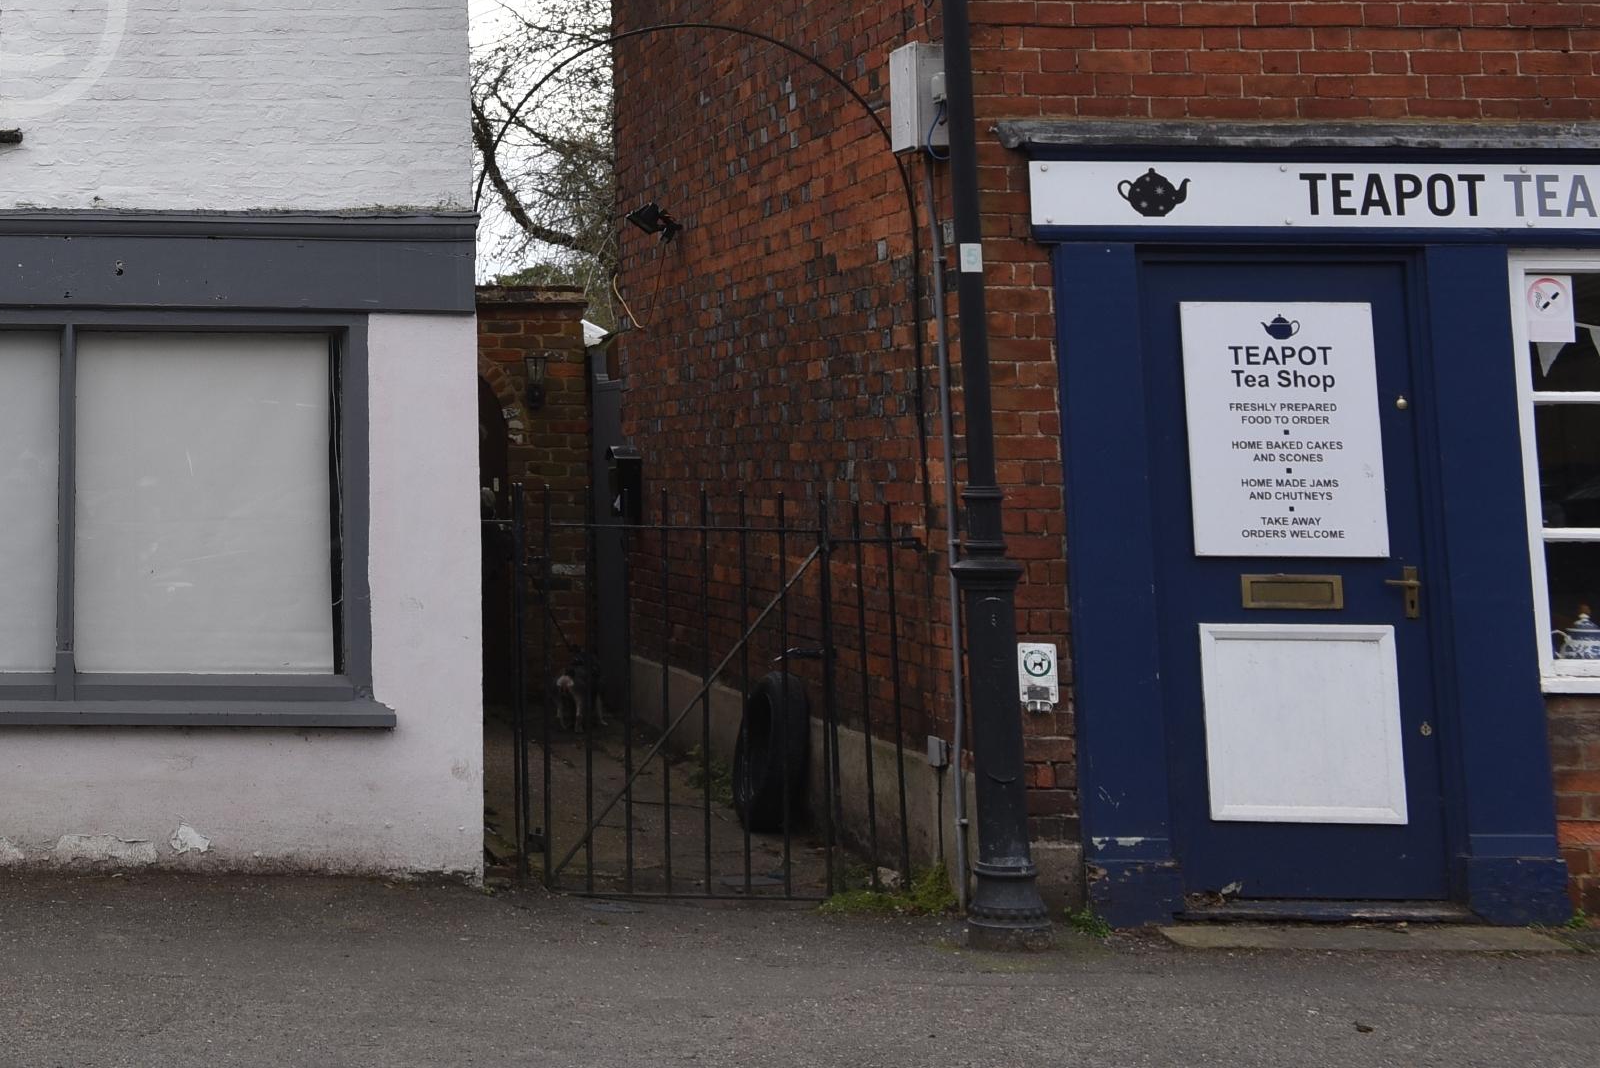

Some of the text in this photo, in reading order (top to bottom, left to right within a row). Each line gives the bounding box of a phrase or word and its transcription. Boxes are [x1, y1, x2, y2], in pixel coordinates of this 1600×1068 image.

[1299, 173, 1598, 218] TEAPOT TEA
[1228, 346, 1332, 365] TEAPOT
[1231, 370, 1335, 392] Tea Shop
[1228, 402, 1338, 412] FRESHLY PREPARED
[1241, 415, 1330, 425] FOOD TO ORDER
[1231, 440, 1344, 451] HOME BAKED CAKES
[1252, 452, 1324, 463] AND SCONES
[1241, 478, 1340, 488] HOME MADE JAMS
[1249, 491, 1333, 501] AND CHUTNEYS
[1260, 516, 1322, 526] TAKE AWAY
[1241, 529, 1345, 539] ORDERS WELCOME
